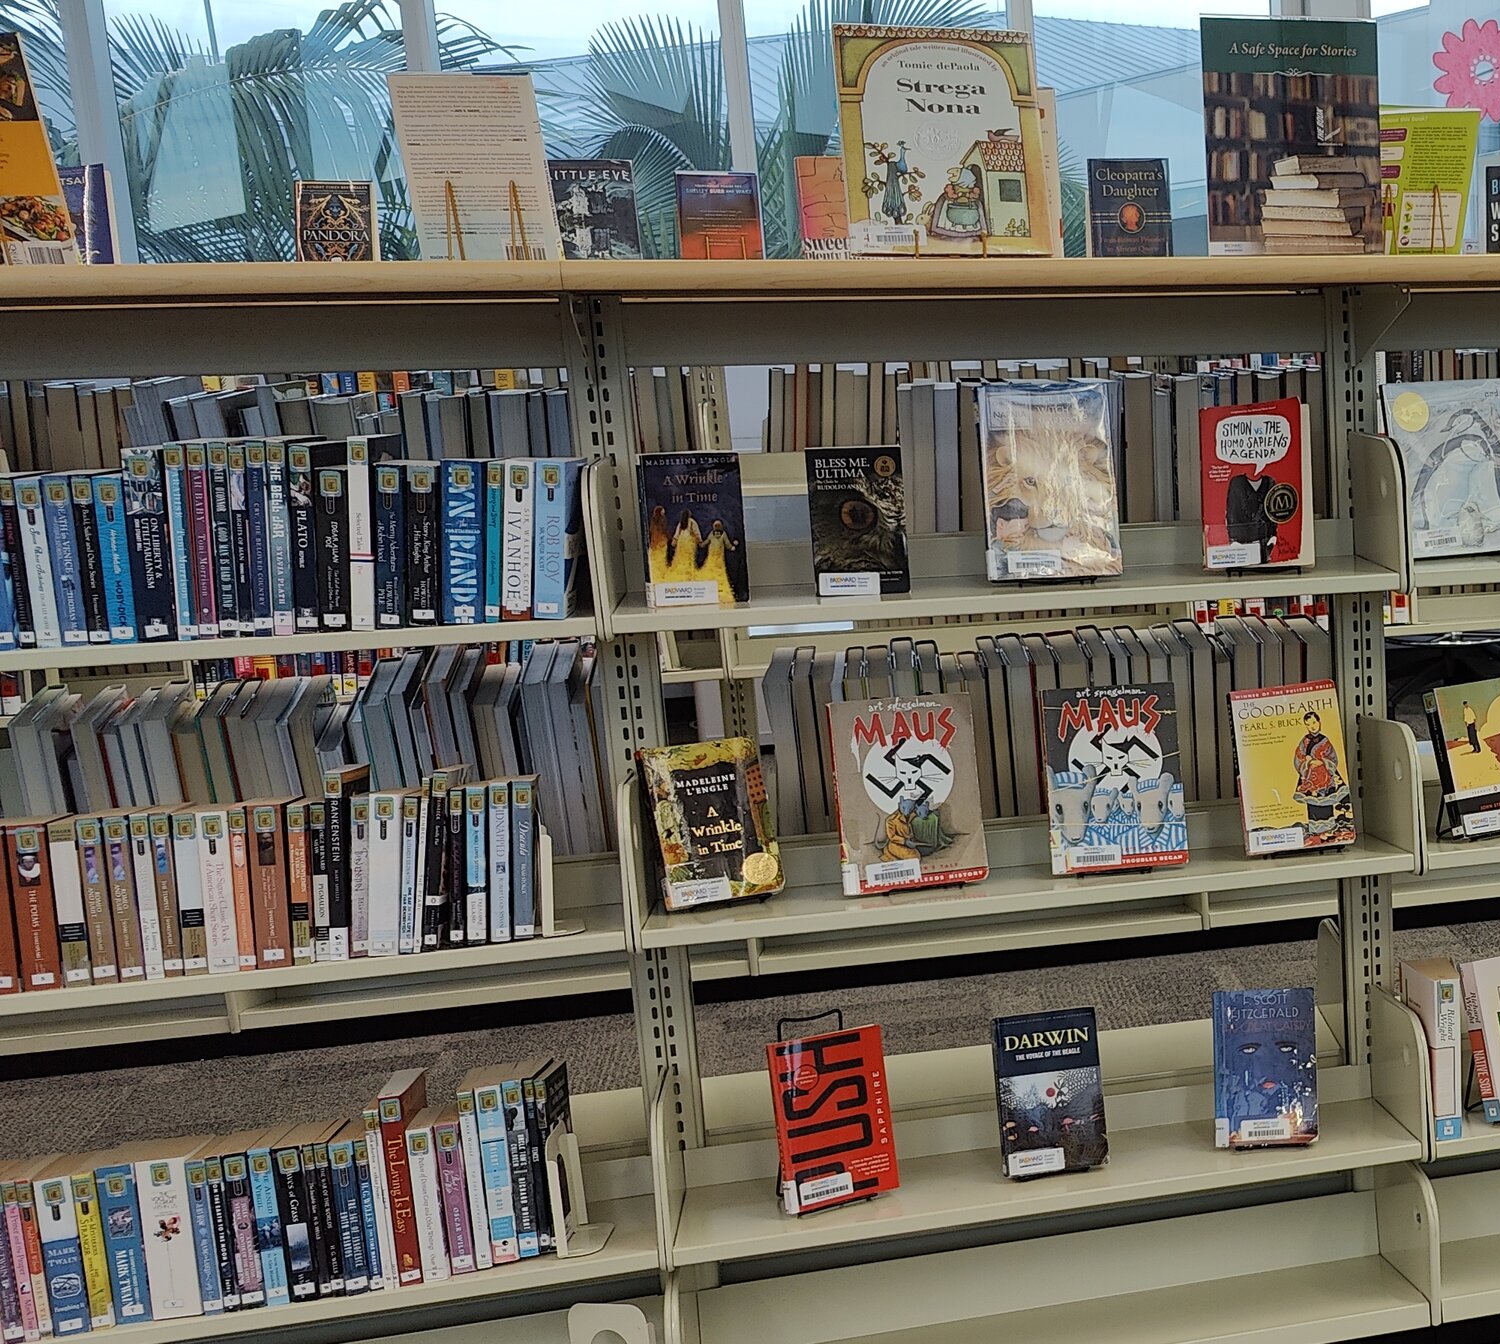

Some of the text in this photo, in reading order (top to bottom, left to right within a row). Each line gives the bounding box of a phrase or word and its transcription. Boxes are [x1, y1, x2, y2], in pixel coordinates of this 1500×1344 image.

[1230, 42, 1357, 59] A Safe Space for Stories
[898, 60, 980, 72] Tomie dePaola
[896, 78, 986, 99] Strega
[905, 98, 982, 114] Nona
[602, 170, 631, 182] EVE
[1096, 168, 1164, 184] Cleopatra's
[1102, 184, 1160, 200] Daughter
[302, 230, 370, 242] PANDORA
[803, 237, 848, 251] Sweet
[1484, 390, 1499, 398] and
[1223, 421, 1281, 437] SIMON THE
[1220, 436, 1289, 455] HOMO SAPIENS
[1229, 449, 1276, 459] AGENDA
[645, 458, 696, 466] MADELEINE
[815, 459, 846, 468] BLESS
[663, 470, 723, 485] A Wrinkle
[815, 468, 865, 478] ULTIMA
[672, 491, 718, 503] in Time
[296, 509, 308, 548] PLATO
[140, 518, 155, 589] UTILITARIANISM
[152, 534, 162, 570] LIBERTY
[389, 540, 398, 572] Adventures
[507, 511, 521, 599] IVANHOE
[545, 515, 560, 584] ROB ROY
[199, 556, 209, 596] Morrison
[448, 535, 477, 601] RAND
[1075, 686, 1147, 699] art spiegelman
[1286, 686, 1313, 694] PULITZER
[868, 697, 942, 712] art spiegelman
[1238, 698, 1333, 720] GOOD EARTH
[853, 706, 957, 749] MAUS
[1059, 695, 1161, 742] MAUS
[1240, 718, 1302, 732] PEARL BUCK
[676, 773, 736, 788] MADELEINE
[686, 784, 729, 796] L'ENGLE
[707, 806, 719, 818] A
[691, 820, 743, 838] Wrinkle
[518, 821, 529, 856] Dracula
[697, 839, 743, 855] in Time
[1122, 856, 1158, 864] TROUBLES
[215, 863, 226, 899] The Signet
[914, 869, 984, 884] BLEEDS HISTORY
[206, 869, 219, 947] American Stories
[318, 883, 327, 918] PYGMALION
[30, 904, 39, 928] POEMS
[1254, 994, 1288, 1005] SCOTT
[1469, 992, 1481, 1024] Richard
[1230, 1007, 1299, 1021] FITZGERALD
[1466, 997, 1475, 1025] Wright
[1440, 1014, 1448, 1042] Wright
[1004, 1027, 1089, 1051] DARWIN
[1026, 1052, 1044, 1060] VOYAGE
[1062, 1047, 1080, 1055] BEAGLE
[1474, 1050, 1492, 1095] NATIVE SON
[872, 1070, 888, 1145] SAPPHIRE
[387, 1135, 412, 1234] The Living Is Easy
[289, 1200, 299, 1222] Grass
[363, 1198, 374, 1222] WELLS
[517, 1177, 531, 1230] RICHARD WRIGHT
[452, 1207, 461, 1232] OSCAR
[79, 1219, 90, 1256] STRANGER
[47, 1247, 76, 1258] MARK
[48, 1256, 78, 1267] TWAIN
[115, 1250, 135, 1308] MARK TWAIN
